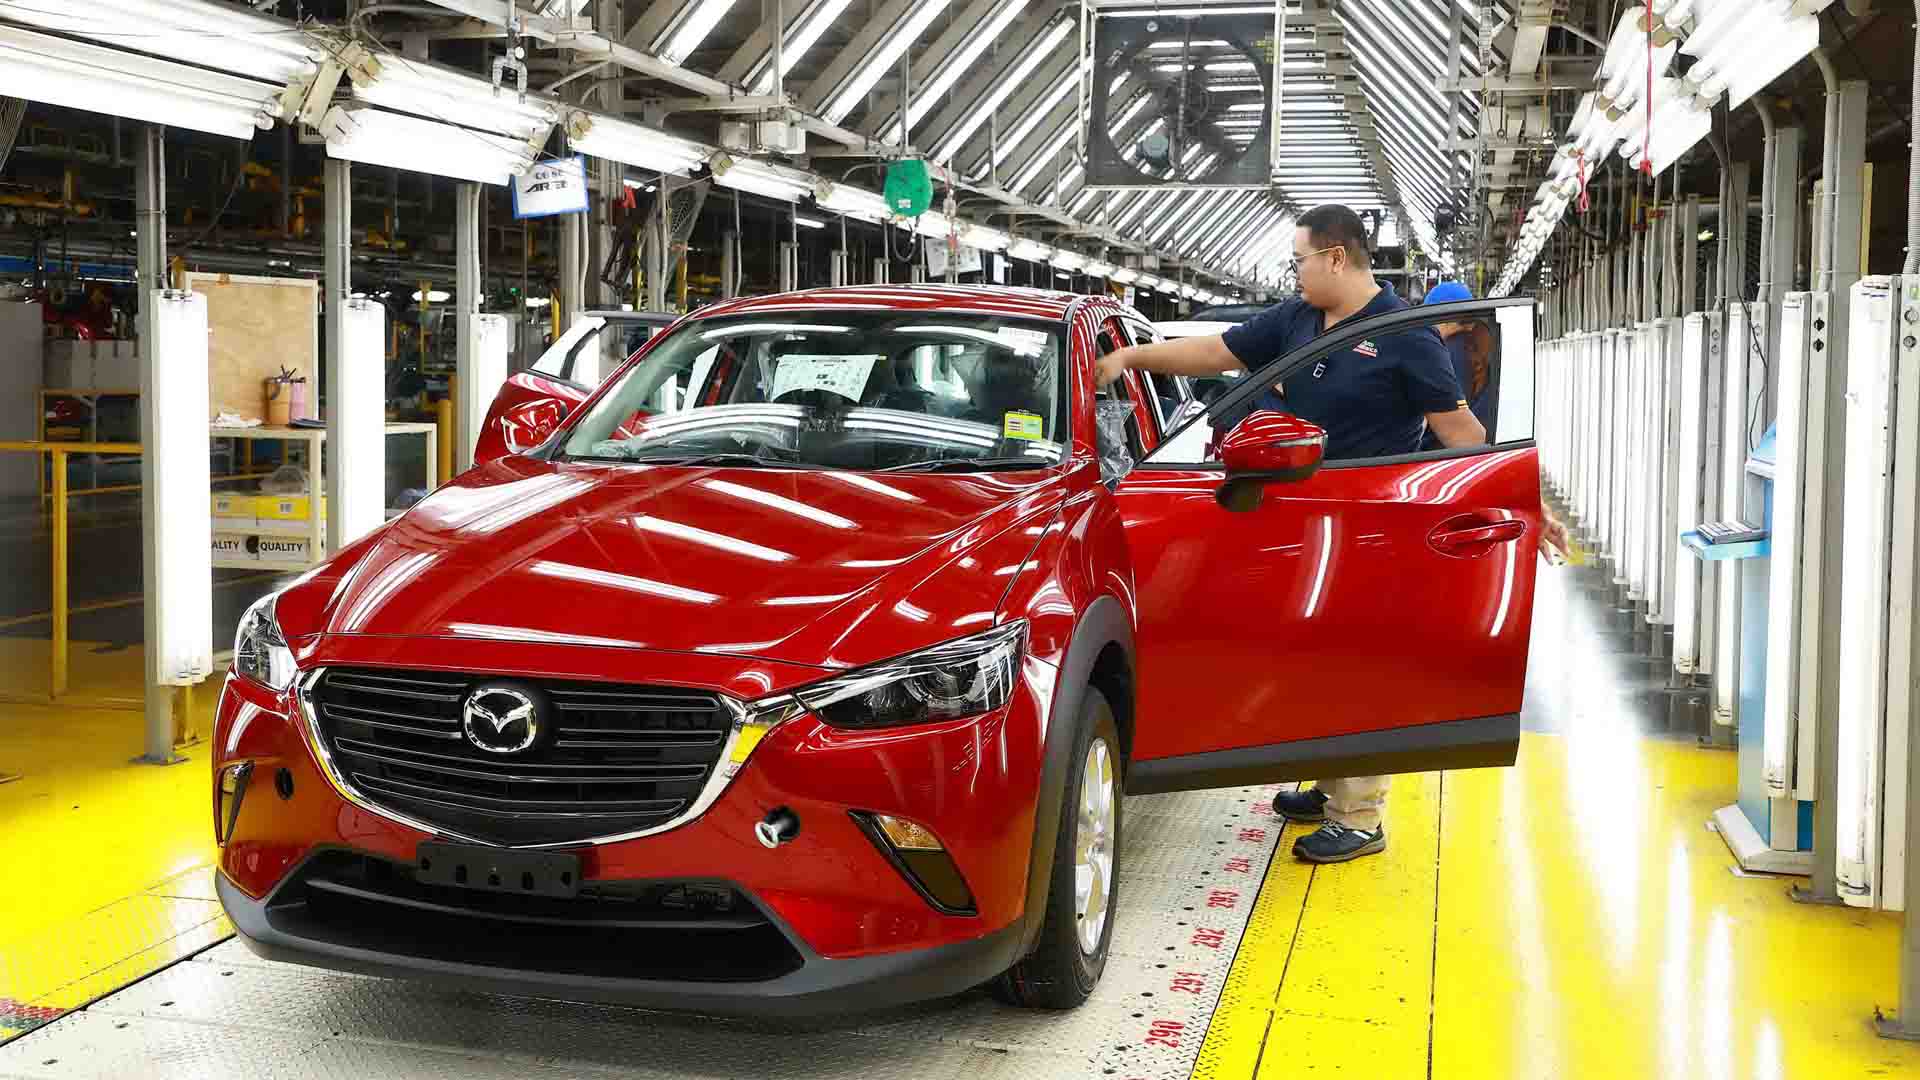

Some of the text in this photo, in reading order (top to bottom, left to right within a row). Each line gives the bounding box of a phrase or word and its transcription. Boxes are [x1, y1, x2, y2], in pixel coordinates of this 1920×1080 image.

[260, 542, 303, 552] QUALITY
[1207, 889, 1240, 910] 293
[1190, 927, 1226, 950] 292
[1168, 971, 1205, 994] 291
[1143, 1019, 1184, 1048] 290
